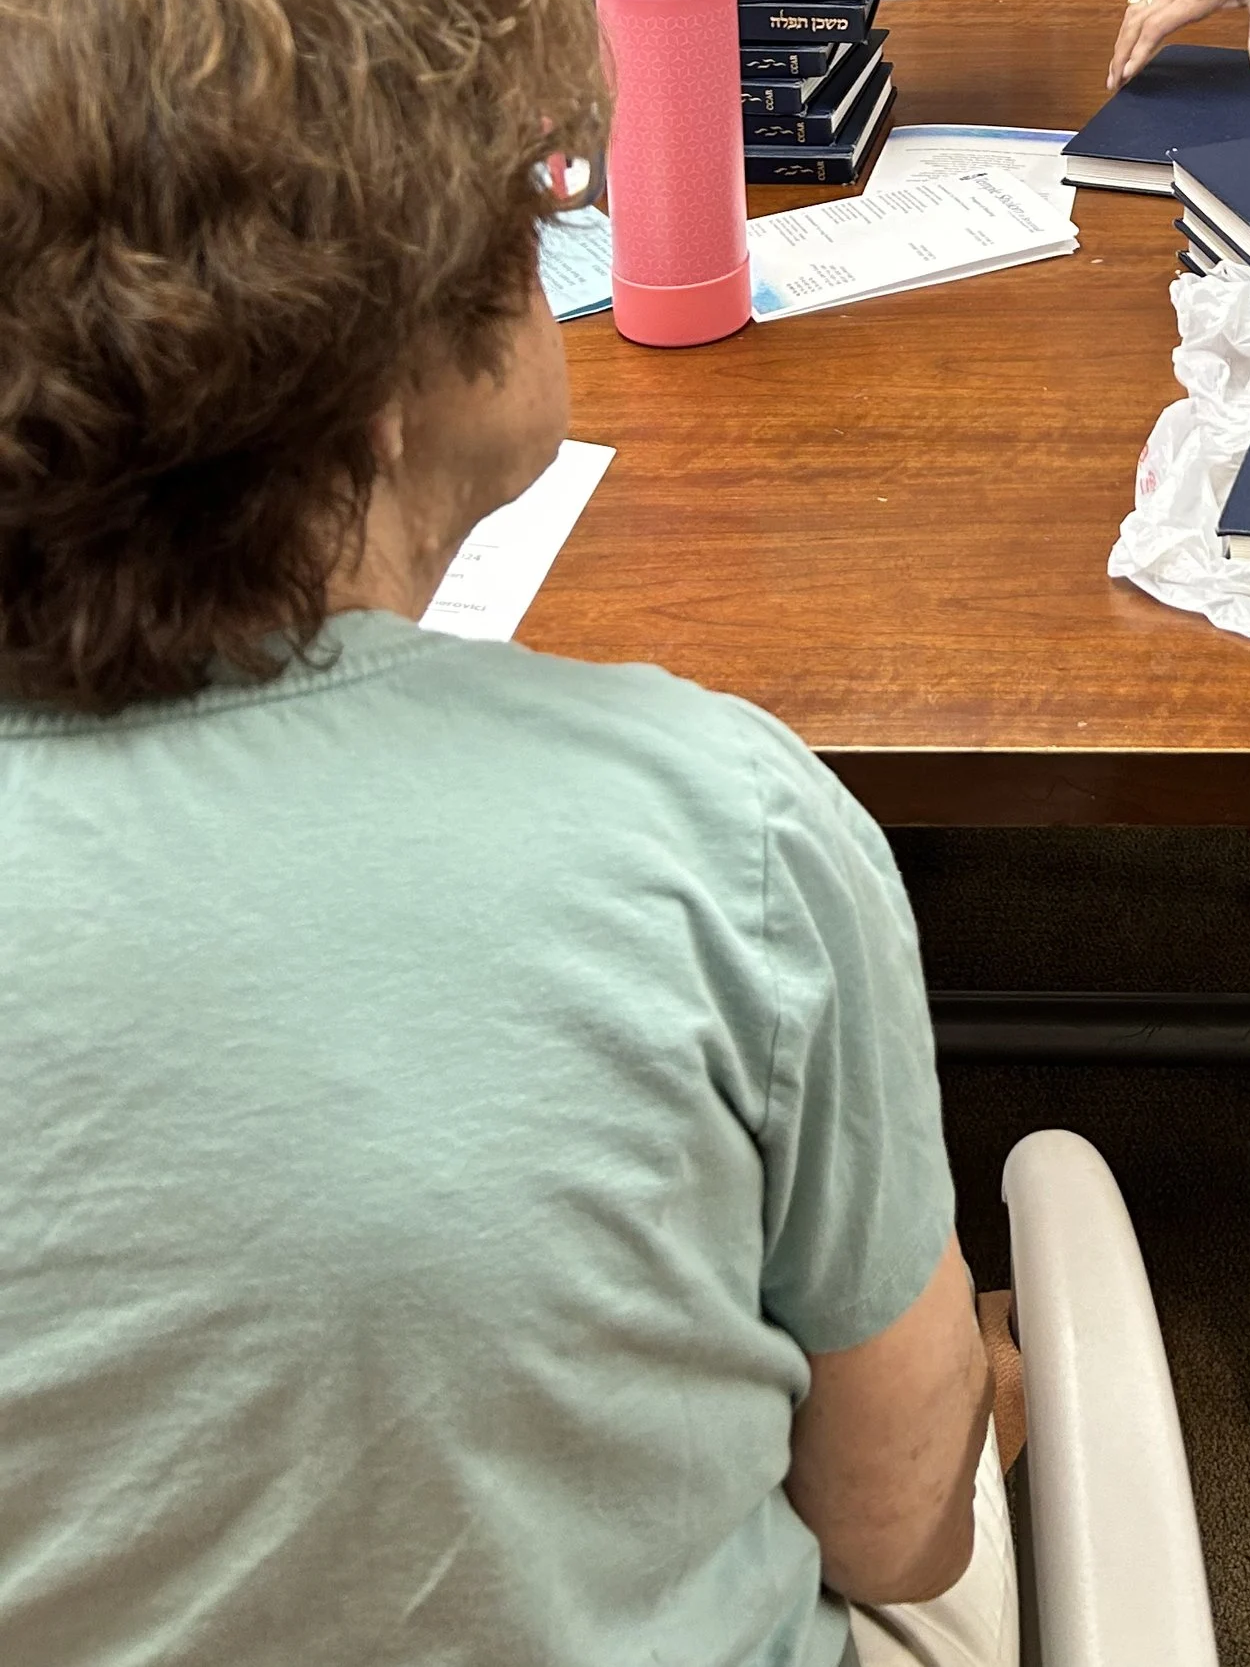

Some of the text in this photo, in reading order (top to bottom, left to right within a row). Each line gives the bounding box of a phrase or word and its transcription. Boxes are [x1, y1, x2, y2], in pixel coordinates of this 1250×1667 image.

[769, 9, 849, 32] משכן תפלה
[789, 54, 799, 75] CCAR
[765, 89, 773, 111] CCAR
[797, 121, 806, 143] CCAR
